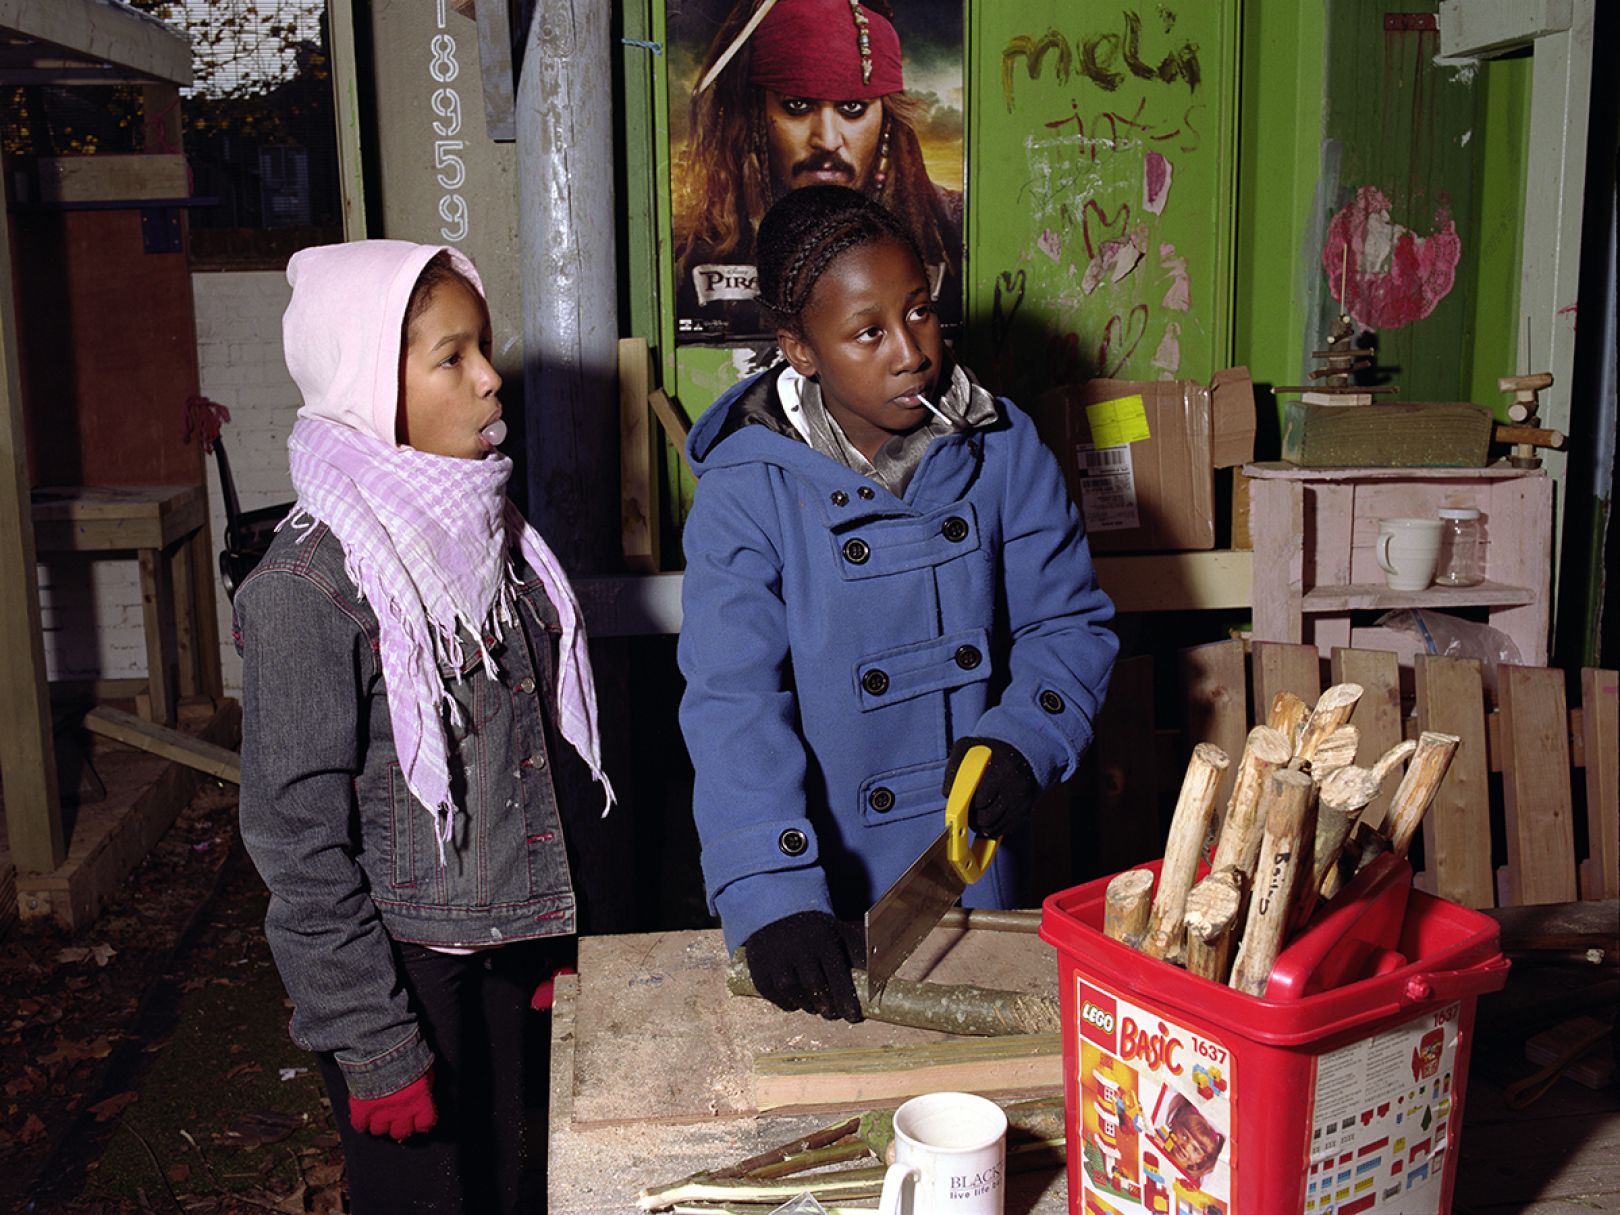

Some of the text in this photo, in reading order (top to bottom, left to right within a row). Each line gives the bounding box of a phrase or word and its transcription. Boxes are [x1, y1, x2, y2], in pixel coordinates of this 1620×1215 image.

[1432, 1003, 1459, 1028] 1637
[1082, 1001, 1114, 1034] LEGO
[1191, 1036, 1227, 1065] 1637
[949, 1185, 990, 1200] live life
